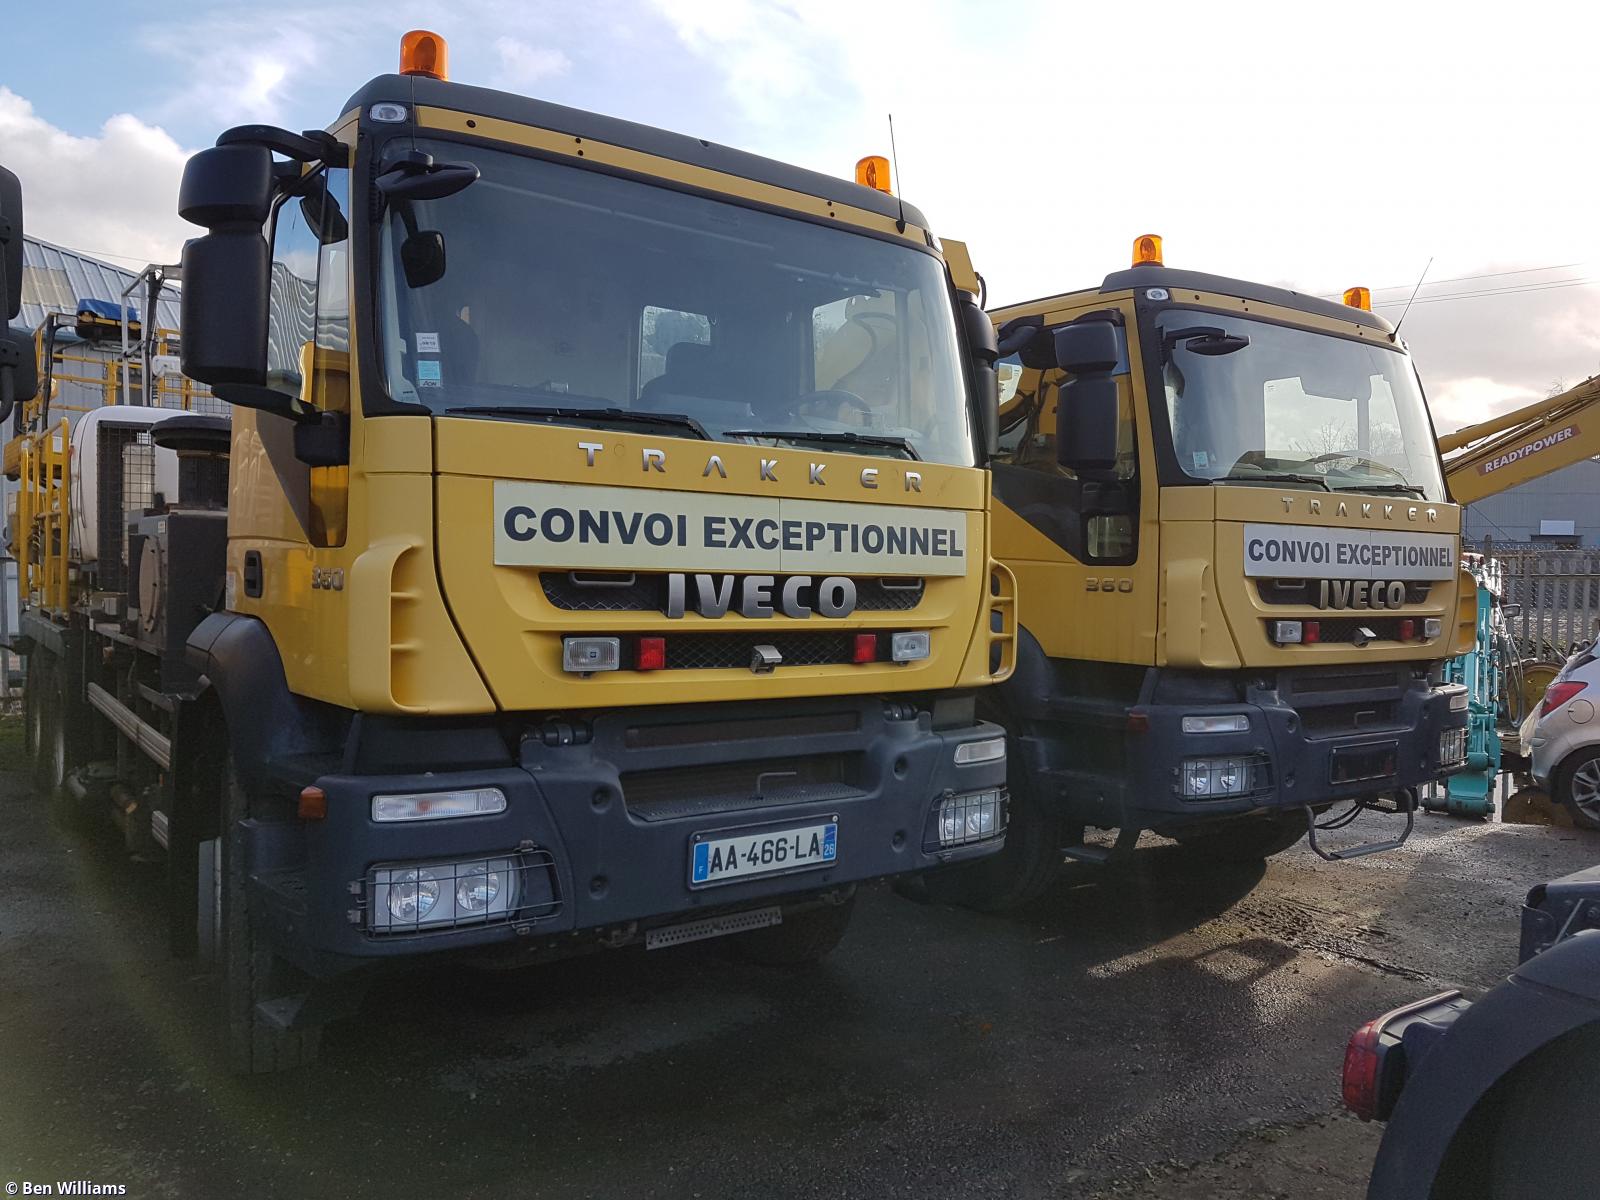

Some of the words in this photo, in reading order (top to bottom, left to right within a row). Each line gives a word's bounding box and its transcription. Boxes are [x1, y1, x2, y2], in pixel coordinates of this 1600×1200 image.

[577, 441, 923, 493] TRAKKER
[1485, 427, 1573, 473] READYPOWER
[1281, 497, 1438, 523] TRAKKER
[503, 505, 688, 548] CONVOI
[703, 516, 965, 558] EXCEPTIONNEL
[1248, 539, 1330, 563] CONVOI
[1336, 543, 1453, 567] EXCEPTIONNEL
[666, 572, 858, 618] IVECO
[1085, 577, 1134, 593] 360
[1319, 579, 1407, 610] IVECO
[709, 832, 821, 873] AA-466-LA
